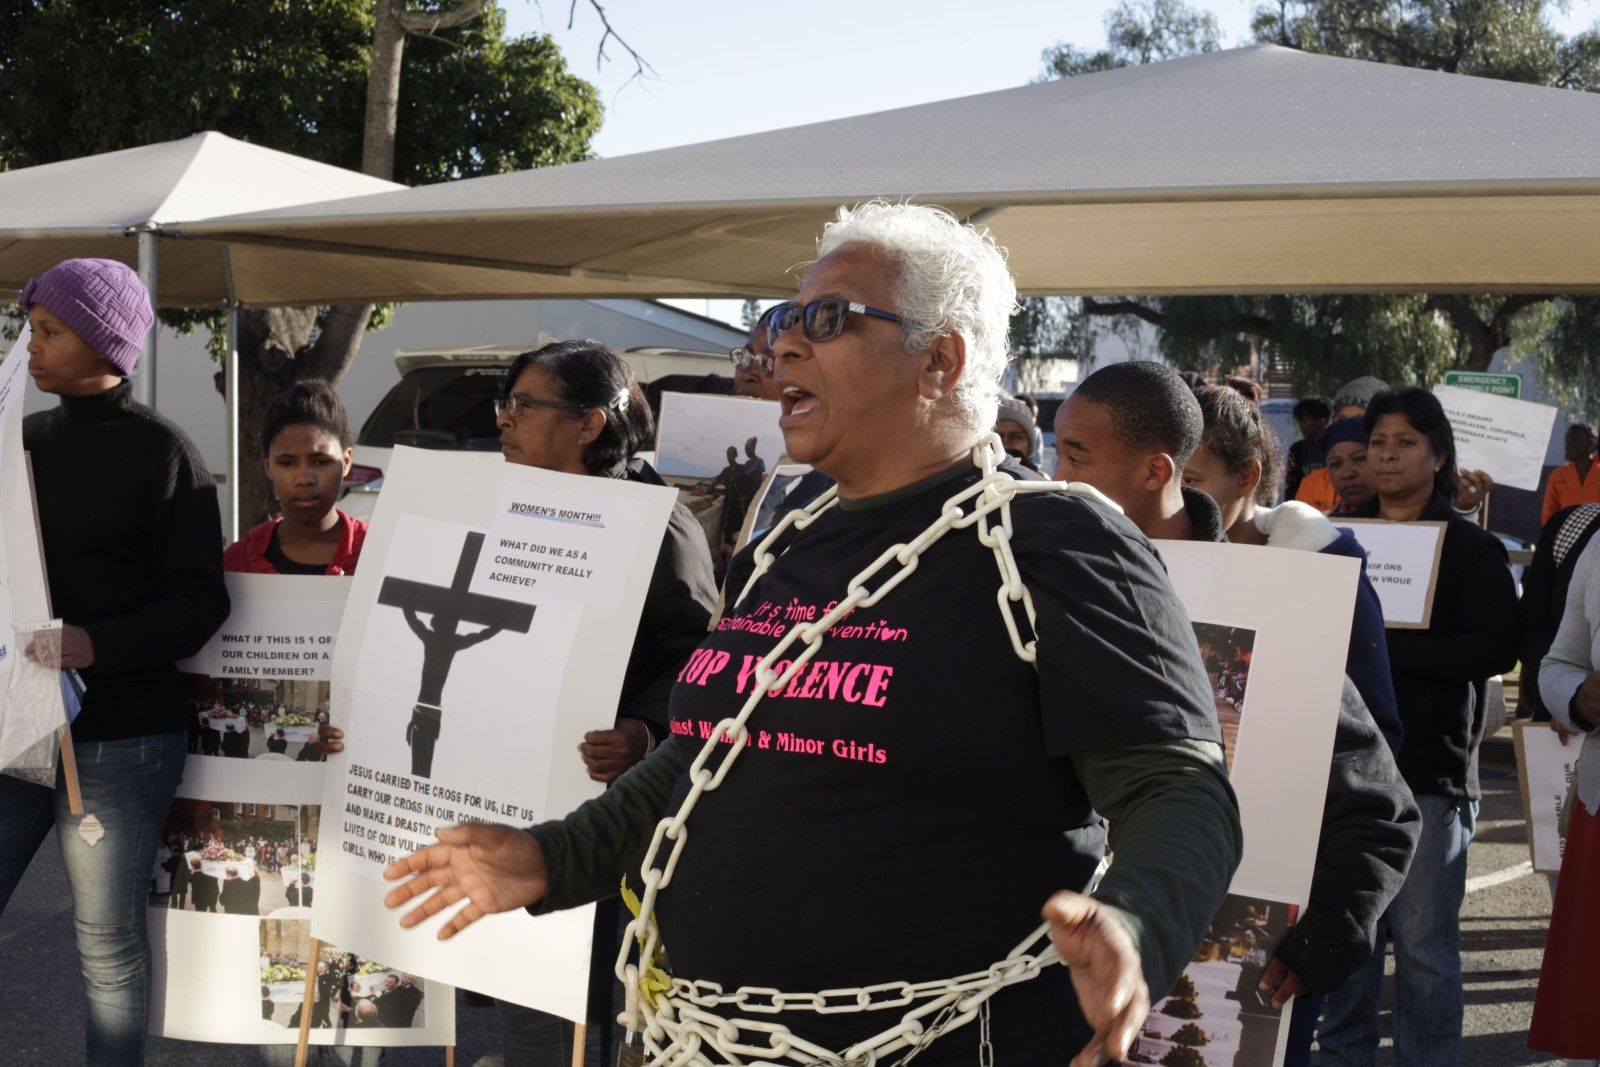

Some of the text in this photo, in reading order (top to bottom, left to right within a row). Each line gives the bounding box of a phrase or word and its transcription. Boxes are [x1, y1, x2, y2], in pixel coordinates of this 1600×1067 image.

[1458, 376, 1507, 384] EMERGENCY
[1491, 386, 1515, 394] POINT
[511, 502, 601, 523] WOMEN'S MONTH!!!
[500, 539, 588, 561] WHAT DID WE AS A
[495, 556, 593, 578] COMMUNITY REALLY
[489, 572, 537, 587] ACHIEVE?
[1381, 576, 1413, 585] VROUE
[784, 597, 816, 621] time
[222, 634, 332, 645] WHAT IF THIS IS 1 OF
[223, 651, 243, 659] OUR
[246, 651, 299, 660] CHILDREN
[303, 652, 318, 660] OR
[223, 666, 315, 676] FAMILY MEMBER?
[677, 648, 894, 708] TOP VOLENCE
[757, 730, 772, 749] &
[777, 733, 825, 754] Minor
[832, 739, 887, 764] Girls
[1564, 763, 1572, 783] OUR
[348, 783, 373, 800] CARRY
[375, 791, 392, 805] OUR
[394, 797, 423, 814] CROSS
[425, 804, 434, 817] IN
[436, 808, 454, 822] OUR
[349, 764, 534, 821] JESUS CARRIED THE CROSS FOR US, LET US
[345, 803, 432, 836] AND MAKE A DRASTIC
[344, 821, 365, 838] LIVES
[367, 829, 378, 841] OF
[379, 833, 396, 848] OUR
[342, 841, 366, 859] GIRLS,
[368, 849, 386, 864] WHO
